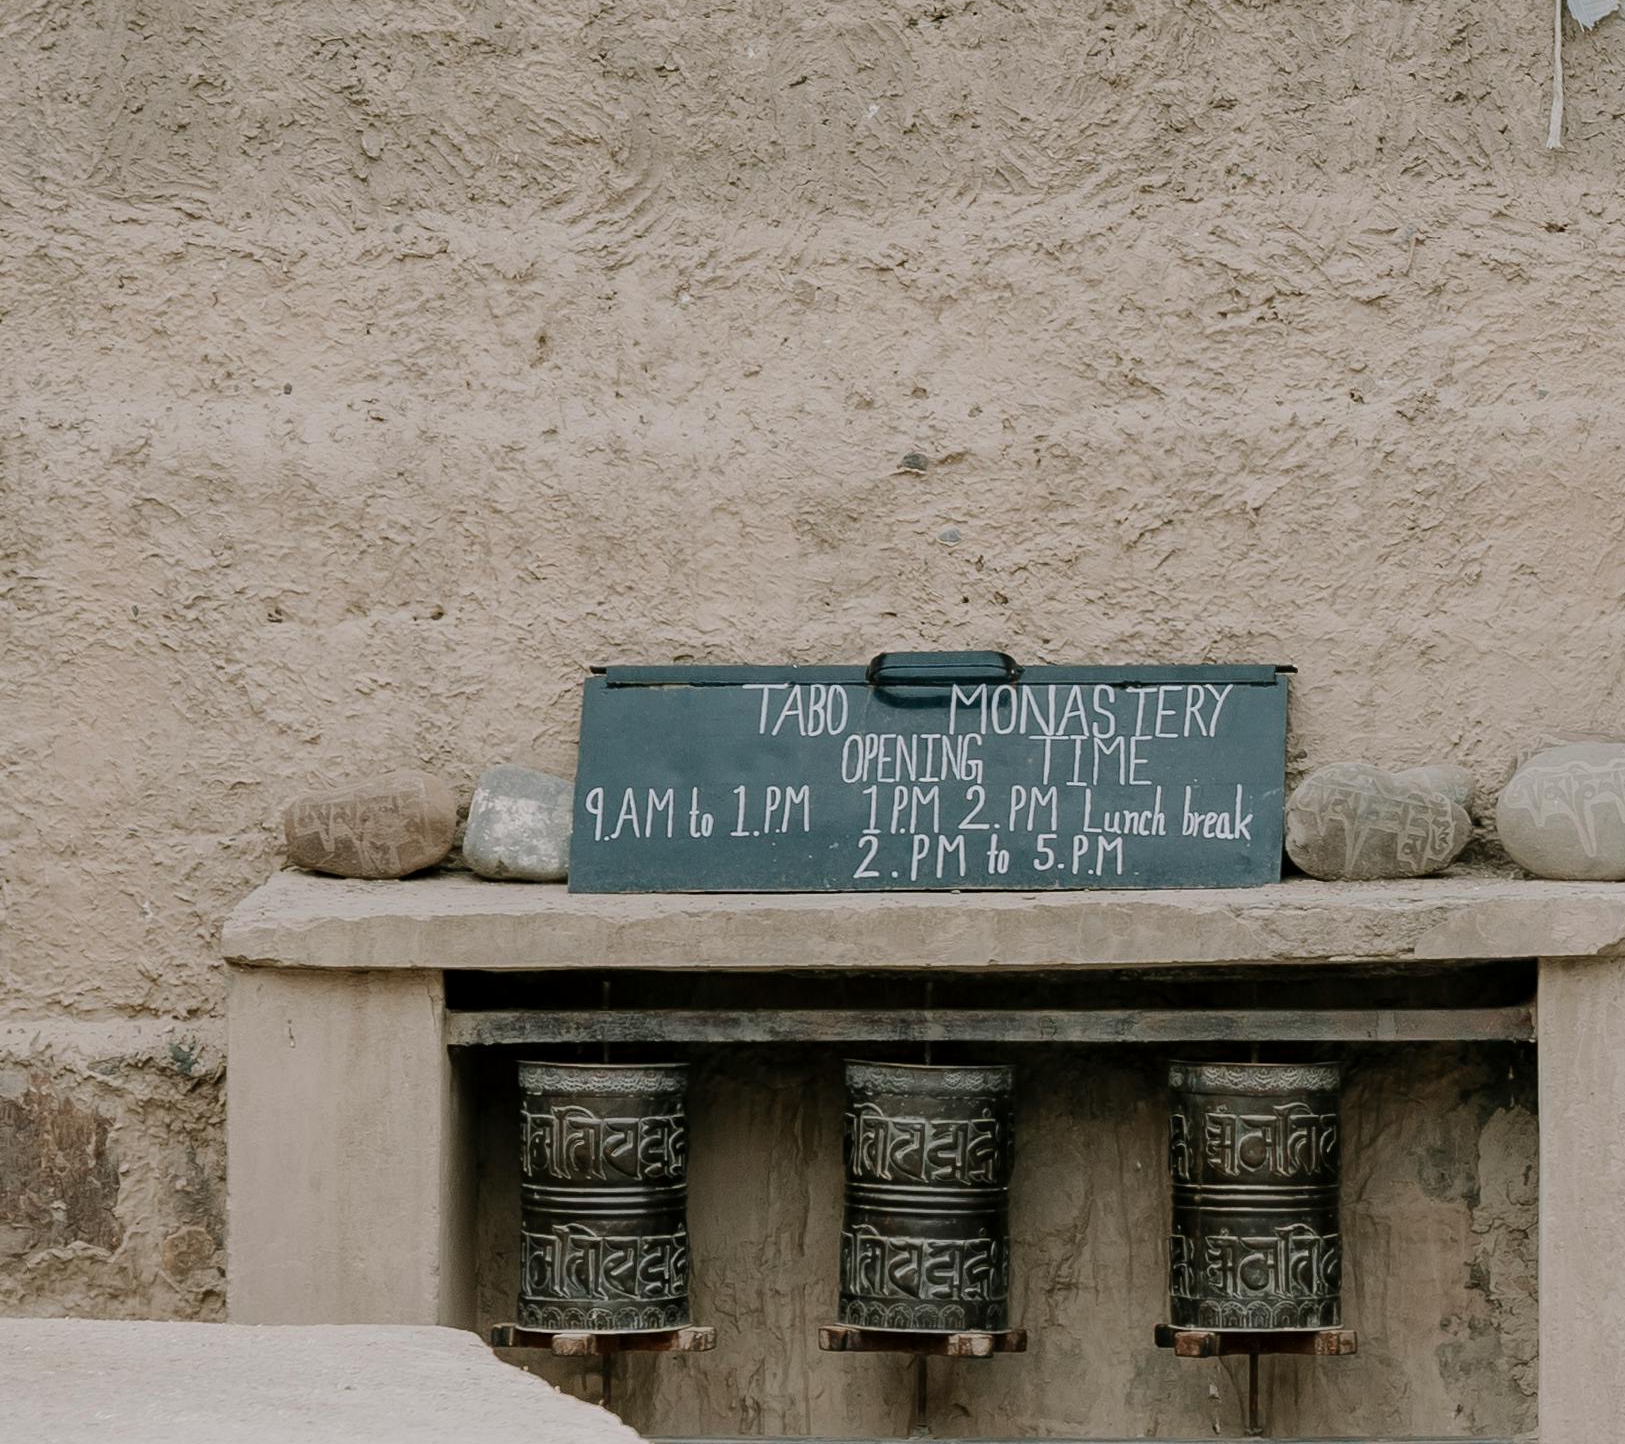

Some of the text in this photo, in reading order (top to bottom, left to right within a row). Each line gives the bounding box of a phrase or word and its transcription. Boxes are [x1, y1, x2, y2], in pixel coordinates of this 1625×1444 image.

[742, 683, 1234, 739] TABO MONASTERY
[841, 733, 1152, 786] OPENING TIME
[585, 787, 674, 841] 9.AM
[689, 786, 714, 838] to
[1083, 785, 1167, 837] Lunch
[1182, 784, 1253, 840] break
[987, 838, 1009, 874] to
